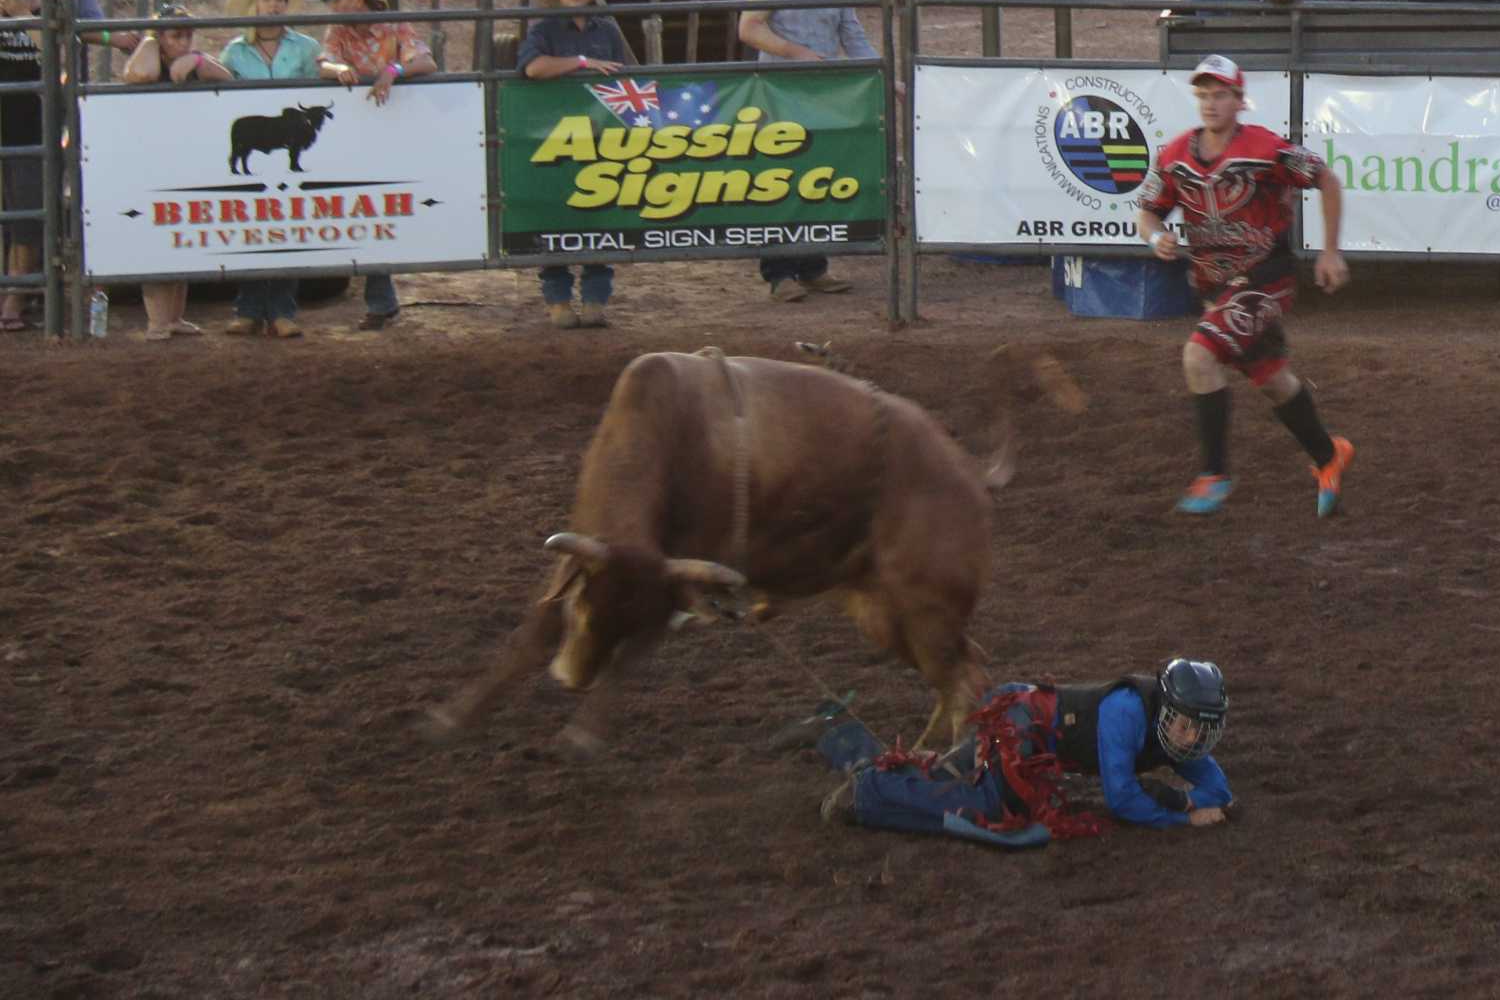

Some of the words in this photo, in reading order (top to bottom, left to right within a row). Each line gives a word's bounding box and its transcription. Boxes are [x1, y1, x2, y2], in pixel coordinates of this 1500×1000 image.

[1065, 76, 1158, 126] CONSTRUCTION
[529, 106, 807, 164] Aussie
[1060, 110, 1131, 140] ABR
[1034, 105, 1102, 211] COMMUNICATIONS
[566, 157, 795, 220] Signs
[797, 166, 861, 200] Co
[152, 192, 414, 226] BERRIMAH
[171, 223, 398, 249] LIVESTOCK
[541, 231, 635, 252] TOTAL
[644, 228, 716, 249] SIGN
[725, 224, 849, 246] SERVICE
[1016, 220, 1065, 238] ABR
[1071, 220, 1139, 239] GROU
